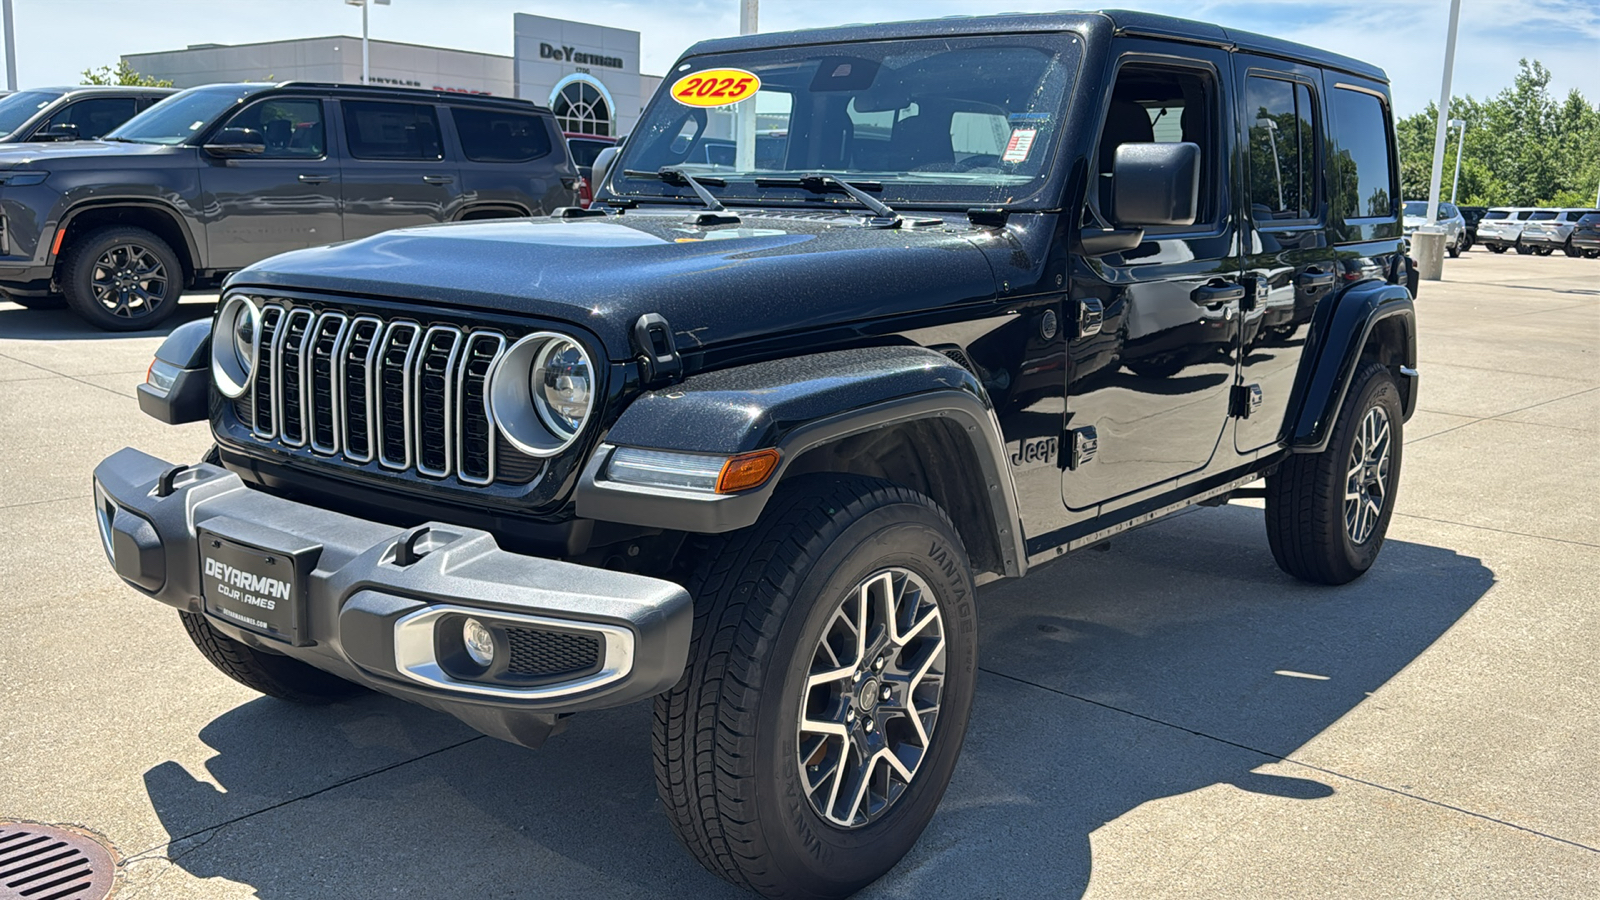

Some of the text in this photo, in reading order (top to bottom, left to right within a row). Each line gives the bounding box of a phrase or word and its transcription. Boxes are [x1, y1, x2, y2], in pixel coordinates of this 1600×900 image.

[540, 42, 623, 69] DeYarman
[677, 78, 753, 97] 2025
[1011, 437, 1058, 466] Jeep
[205, 557, 291, 600] DEYARMAN
[928, 541, 973, 634] VANTAGE
